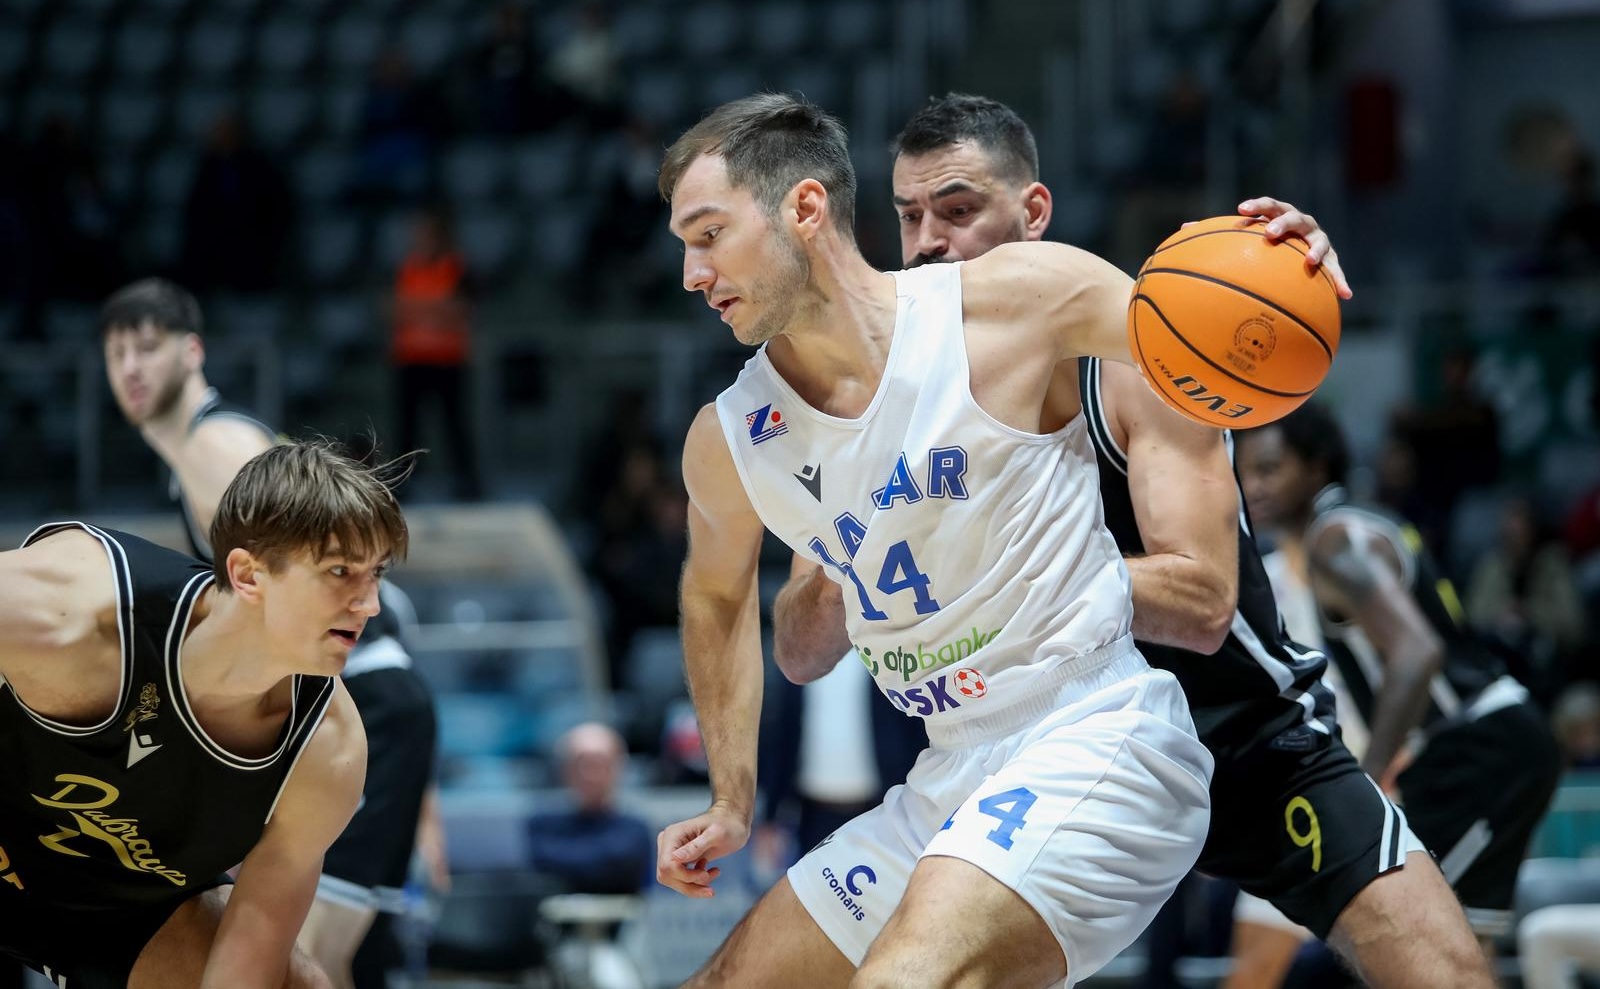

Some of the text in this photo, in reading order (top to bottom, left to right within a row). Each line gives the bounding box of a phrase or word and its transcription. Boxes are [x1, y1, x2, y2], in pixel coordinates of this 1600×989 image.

[1153, 357, 1254, 418] EVO NXT
[846, 539, 941, 621] 14
[31, 773, 187, 887] Dubrava
[1285, 796, 1322, 873] 9
[821, 866, 866, 922] cromaris
